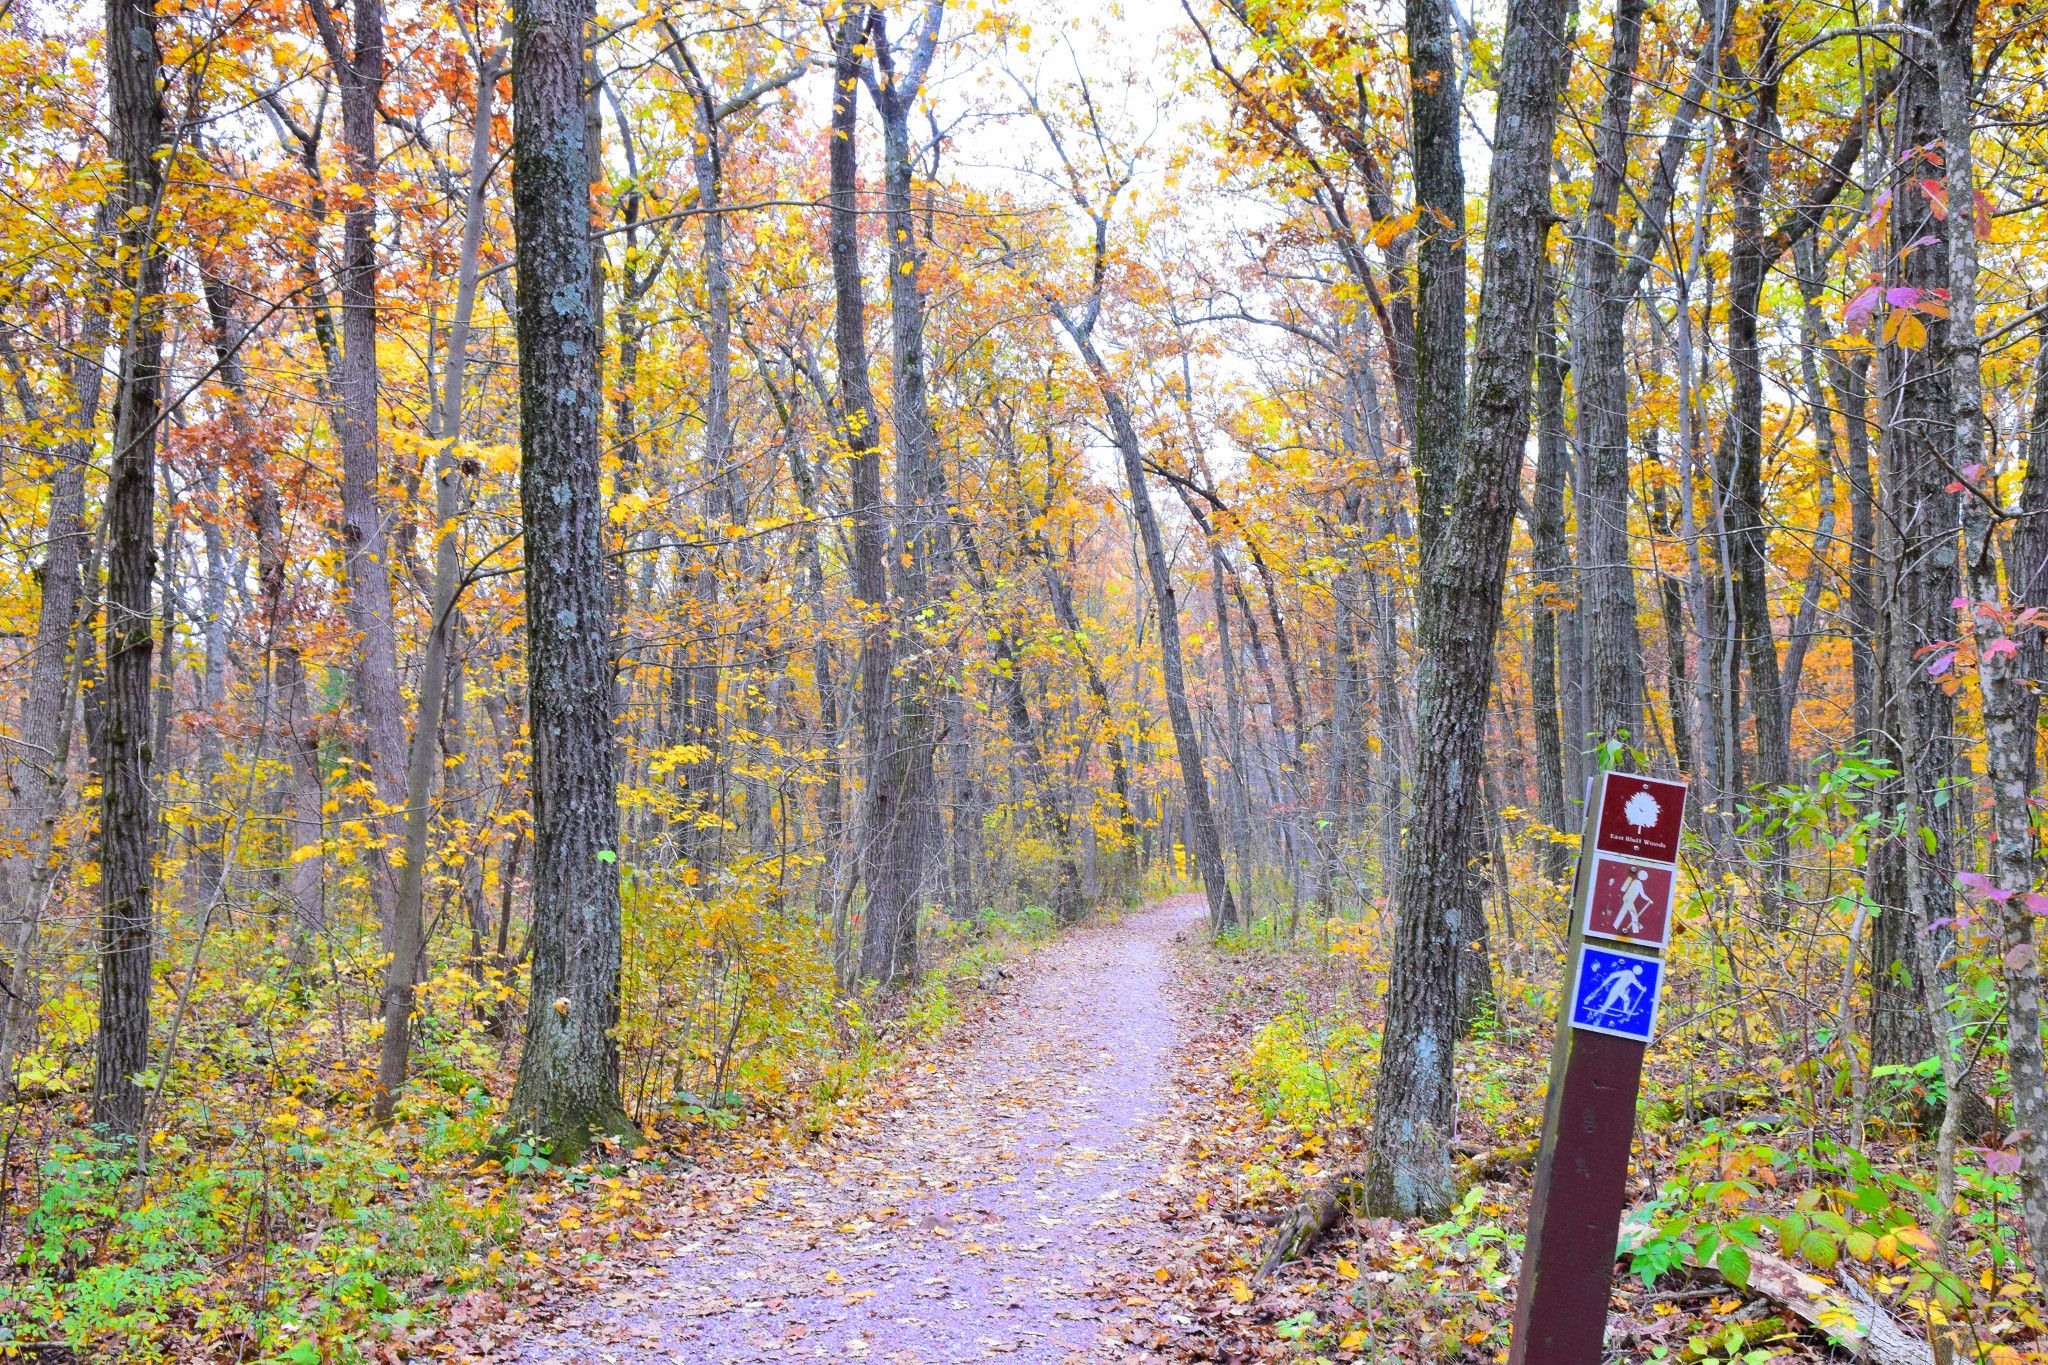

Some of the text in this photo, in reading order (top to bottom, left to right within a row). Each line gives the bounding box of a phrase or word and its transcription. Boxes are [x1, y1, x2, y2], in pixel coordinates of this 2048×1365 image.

[1610, 833, 1666, 848] East Bluff Woods
